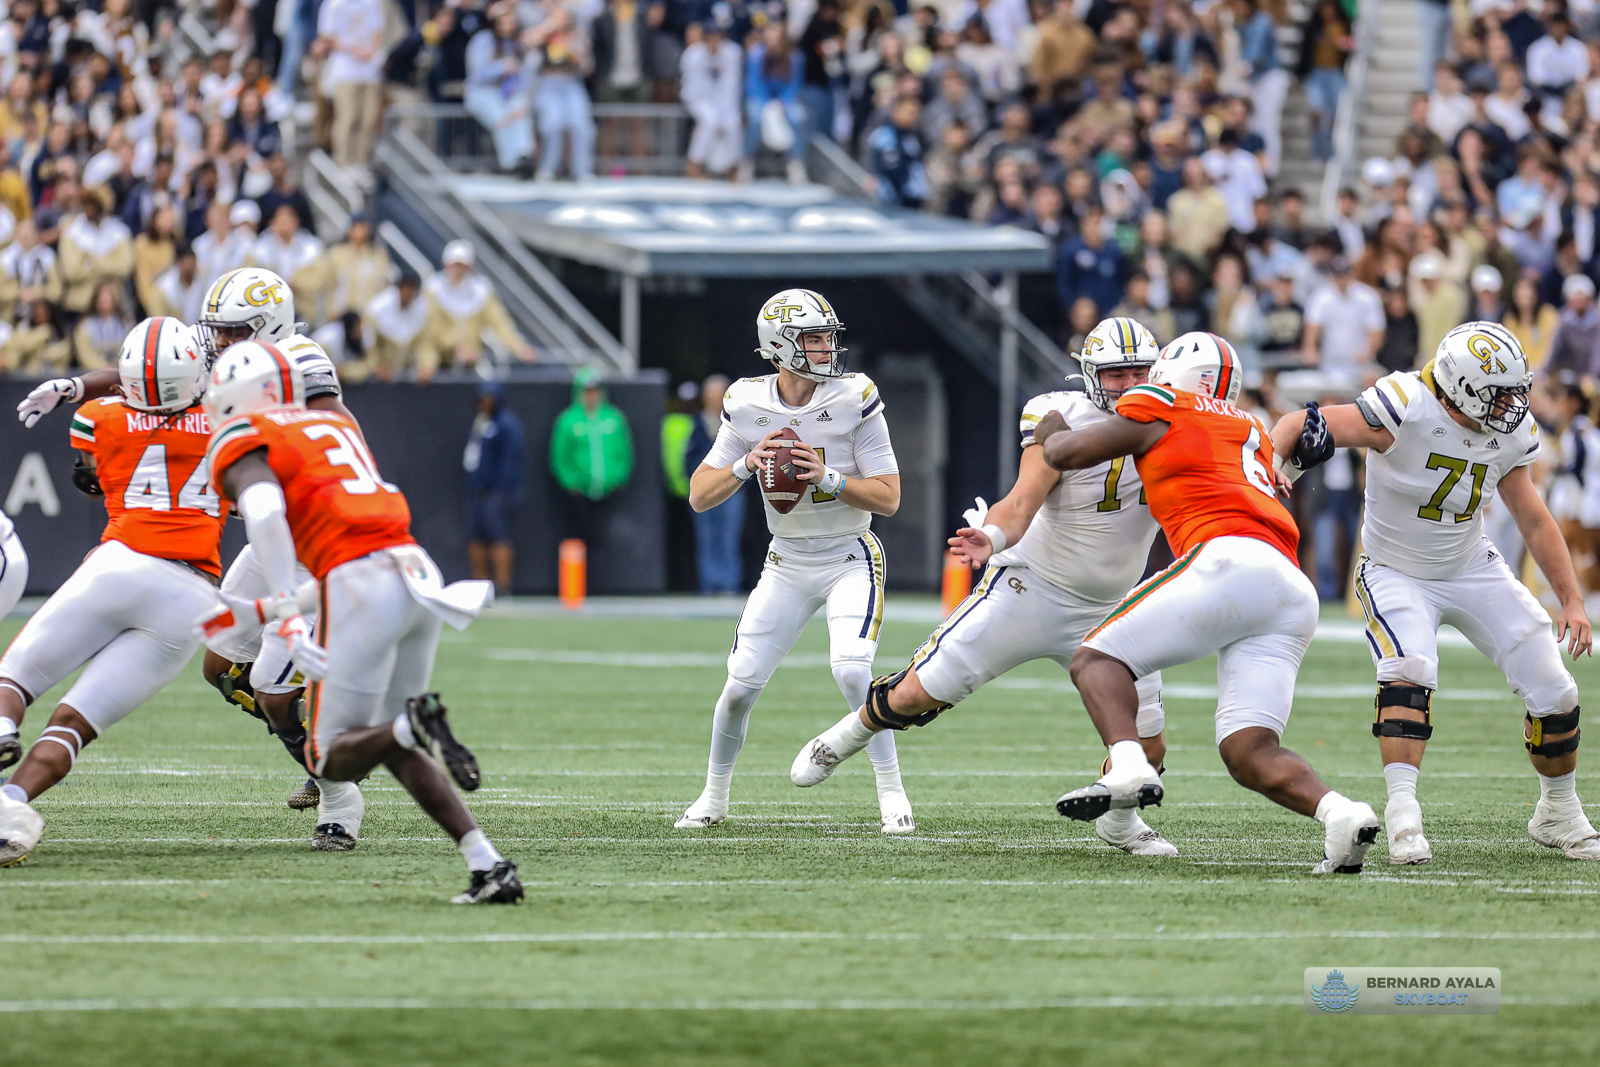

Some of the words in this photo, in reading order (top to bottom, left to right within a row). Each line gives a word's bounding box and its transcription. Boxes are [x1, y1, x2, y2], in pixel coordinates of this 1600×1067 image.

[763, 298, 802, 323] GT
[4, 452, 61, 517] A
[123, 443, 220, 518] 44
[1241, 425, 1277, 499] 6
[1417, 452, 1489, 524] 71
[1008, 576, 1027, 594] GT
